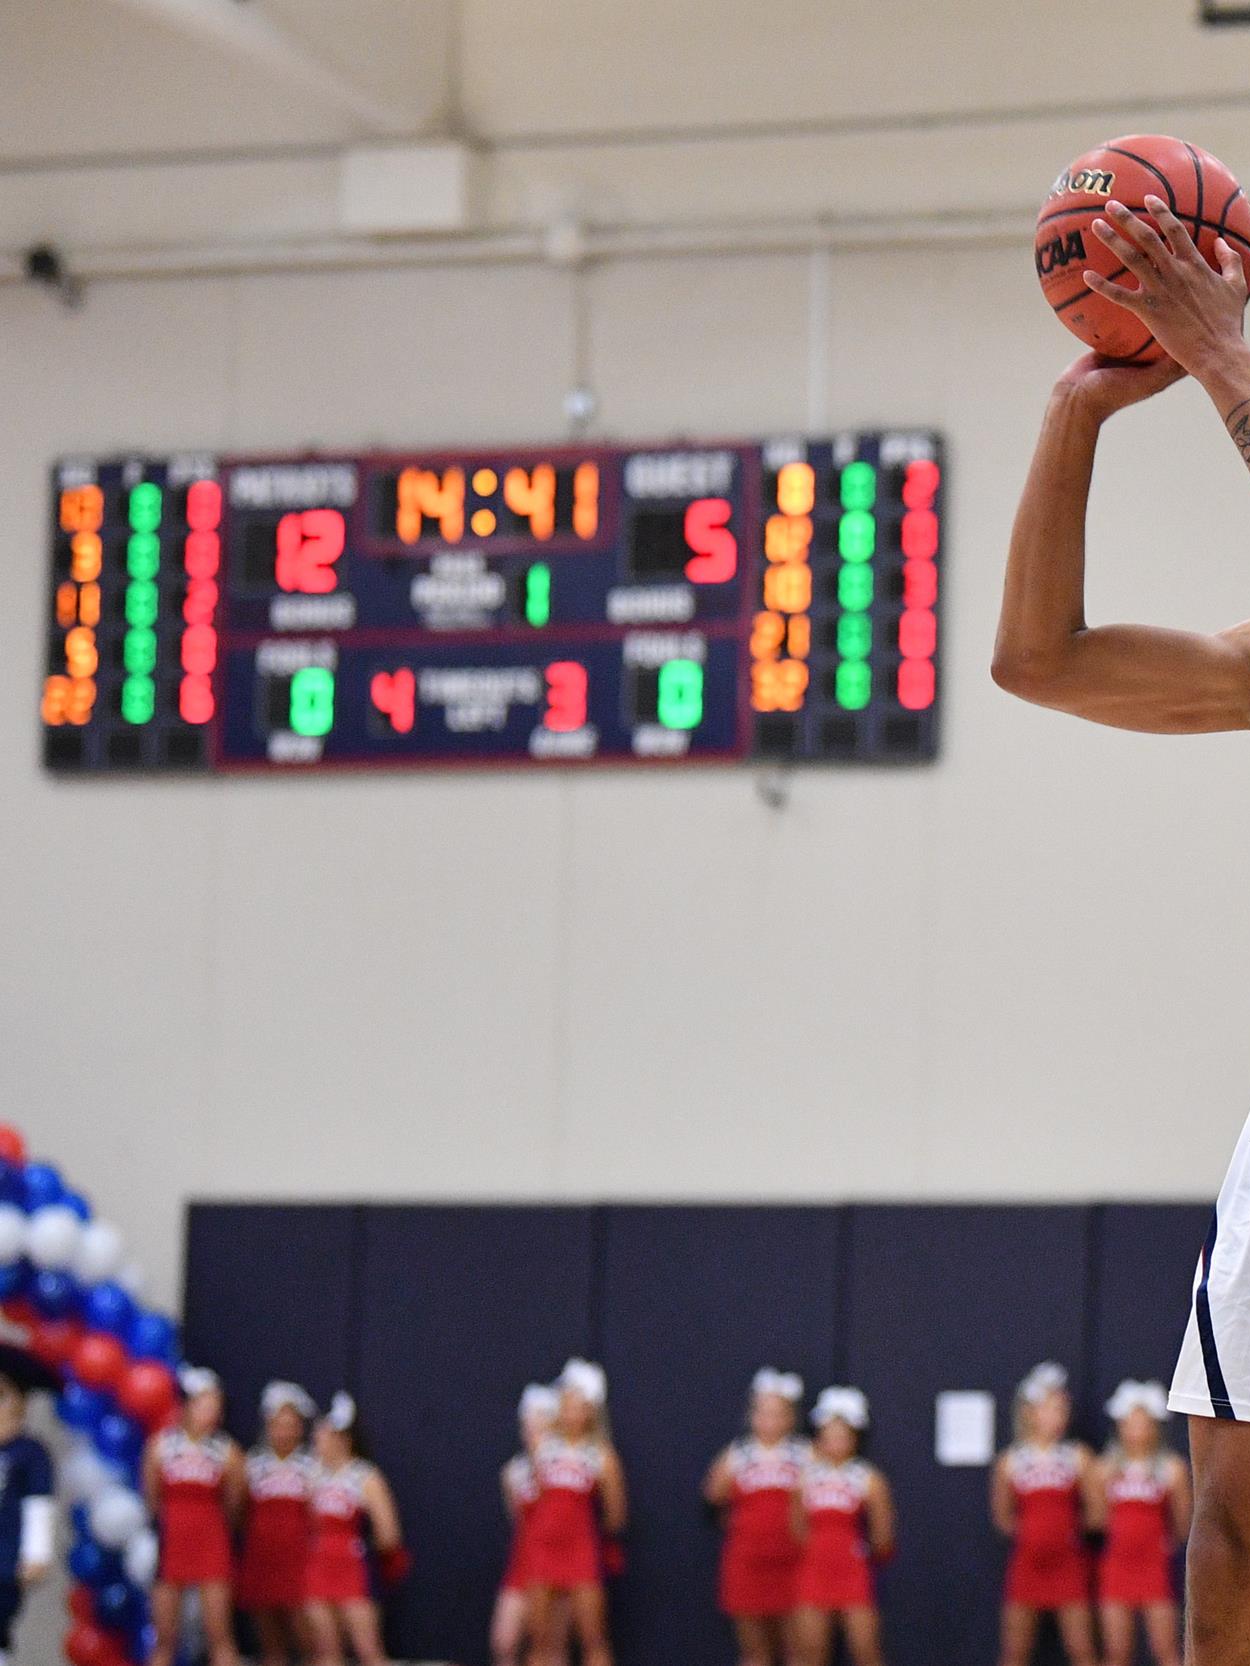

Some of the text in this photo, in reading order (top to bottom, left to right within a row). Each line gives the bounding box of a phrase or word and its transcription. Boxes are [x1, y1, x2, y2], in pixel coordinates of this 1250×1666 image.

[396, 461, 598, 544] 14:41
[684, 498, 737, 583] 5
[276, 509, 345, 593] 12
[526, 561, 550, 628] 1
[371, 667, 415, 733] 4
[544, 661, 587, 731] 3
